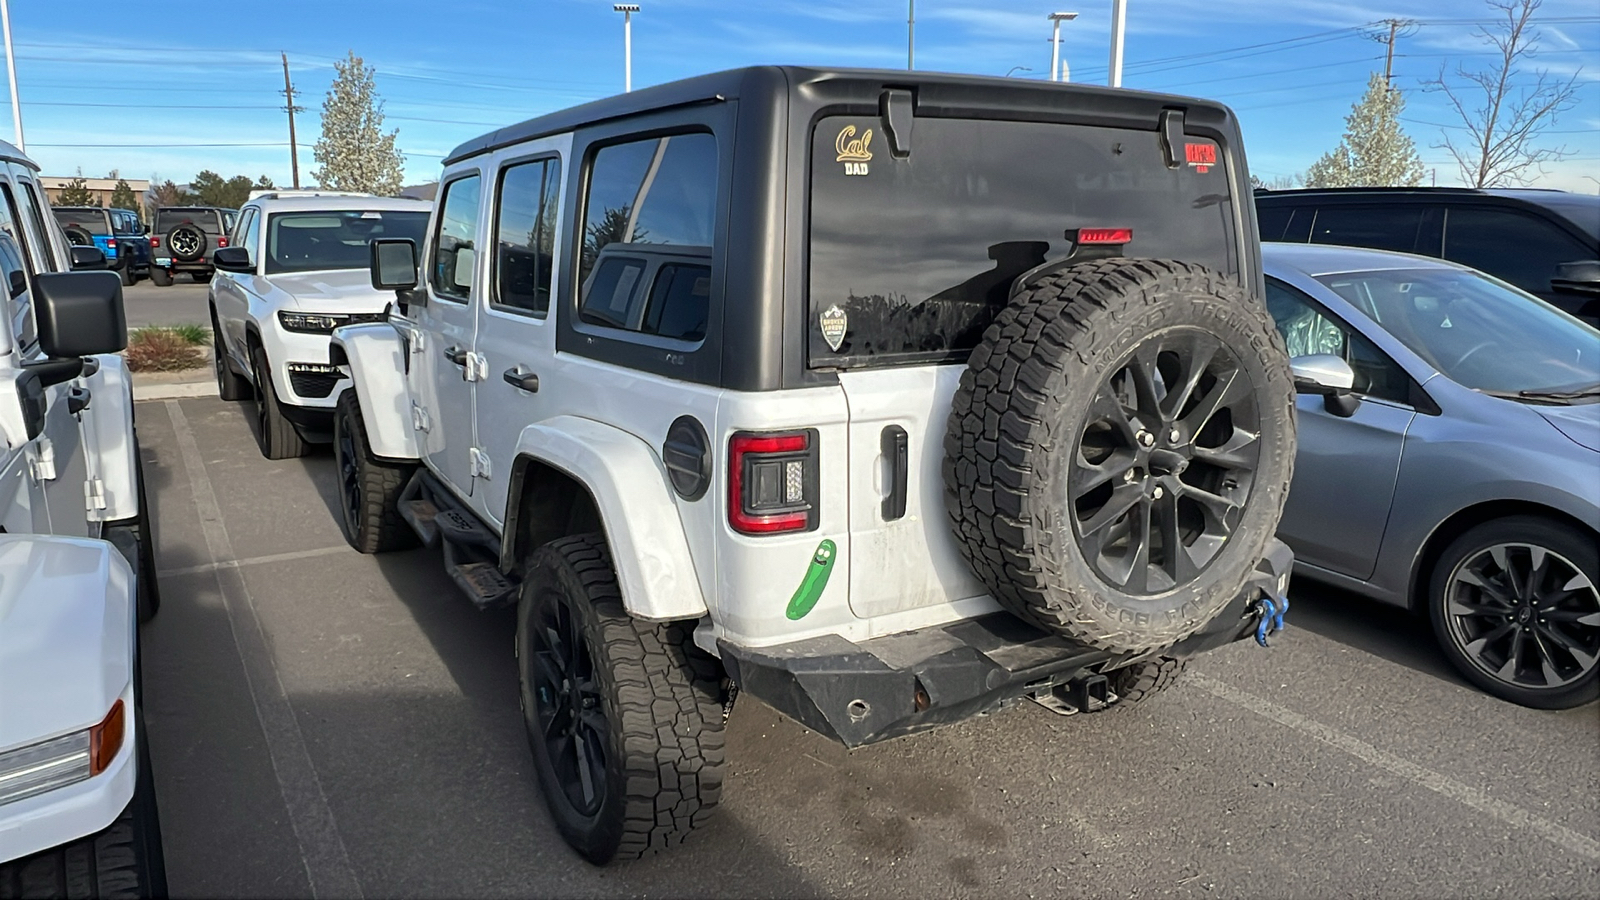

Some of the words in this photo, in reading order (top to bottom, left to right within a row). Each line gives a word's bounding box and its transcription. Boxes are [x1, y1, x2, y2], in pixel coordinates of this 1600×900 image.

[835, 124, 873, 162] Cal
[844, 162, 868, 175] DAD
[1190, 299, 1279, 383] THOMPSON
